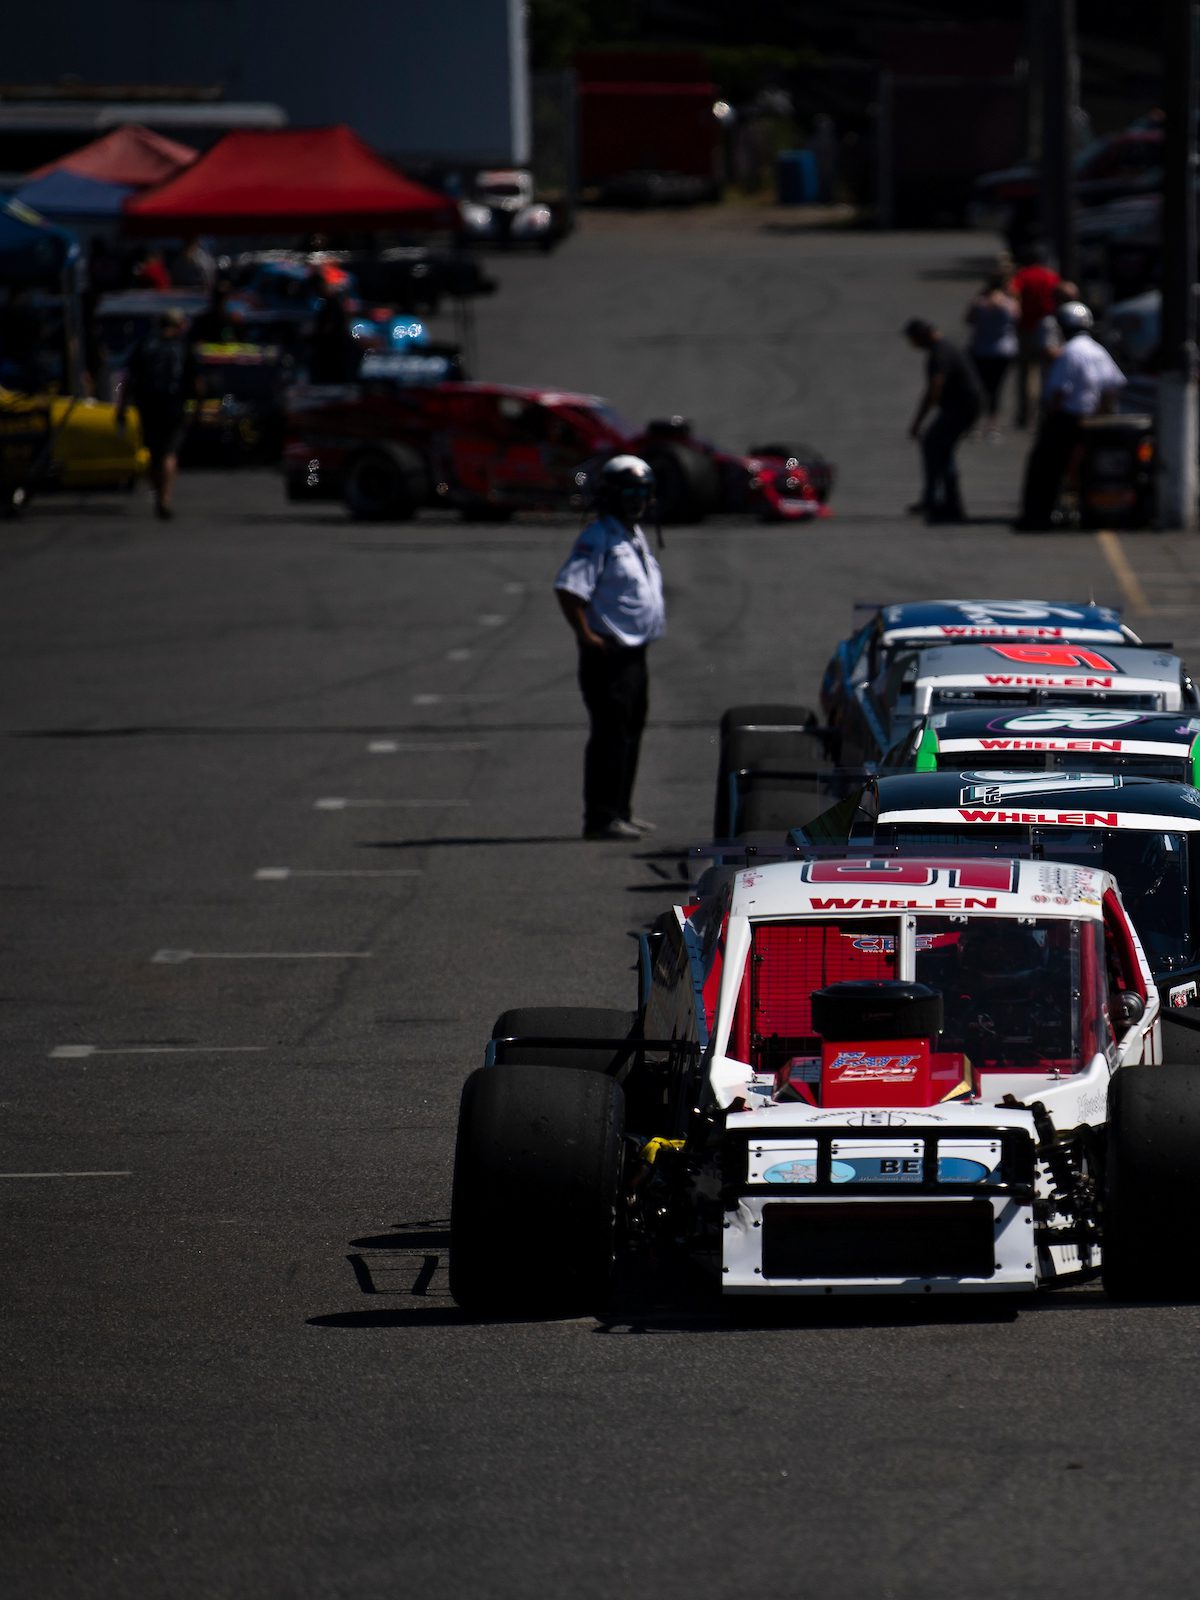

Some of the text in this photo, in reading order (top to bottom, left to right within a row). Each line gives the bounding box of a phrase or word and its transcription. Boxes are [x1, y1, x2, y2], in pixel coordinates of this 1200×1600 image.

[939, 625, 1063, 639] WHELEN
[984, 674, 1112, 688] WHELEN
[978, 739, 1123, 751] WHELEN
[958, 809, 1118, 826] WHELEN
[809, 897, 997, 910] WHELEN
[879, 1159, 941, 1175] BE
